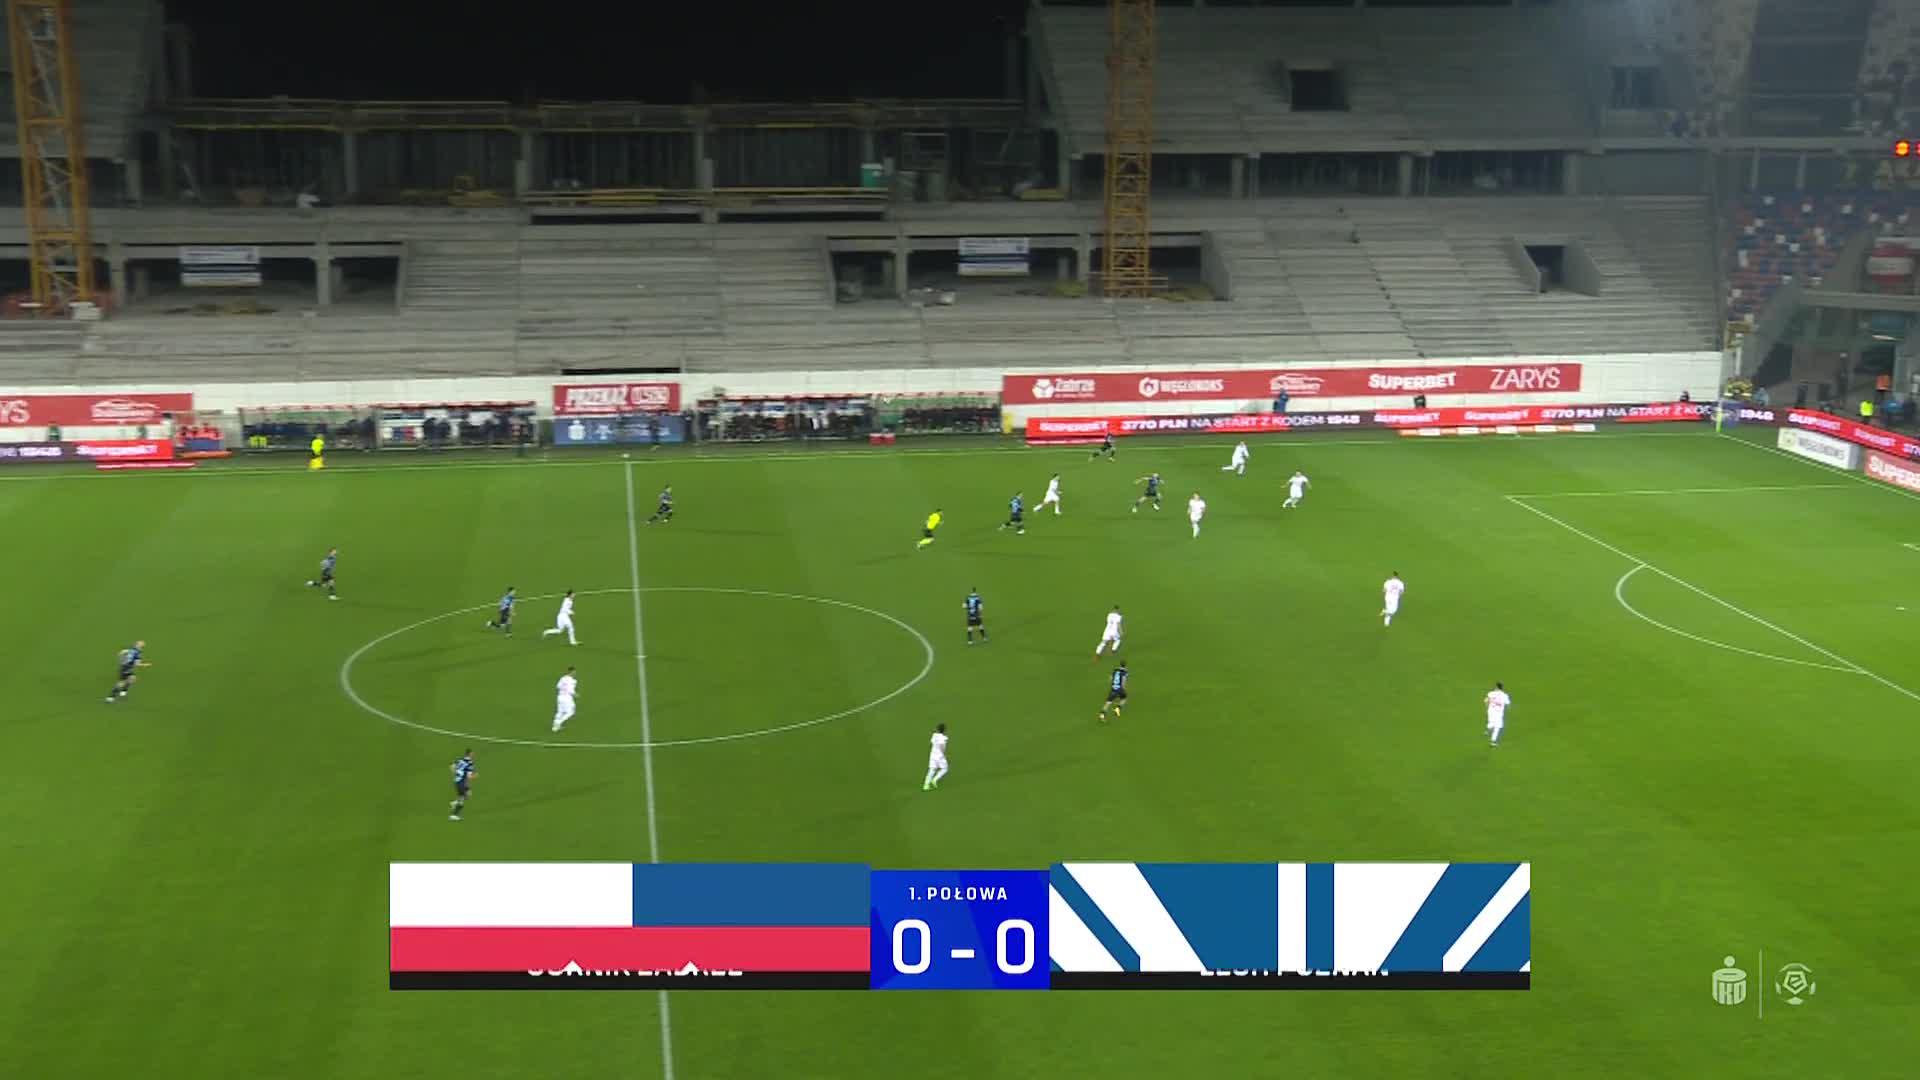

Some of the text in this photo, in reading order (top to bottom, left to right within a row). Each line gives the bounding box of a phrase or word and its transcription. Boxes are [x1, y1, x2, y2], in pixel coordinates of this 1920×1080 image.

[1368, 372, 1456, 390] SUPERBET
[1490, 367, 1560, 390] ZARYS
[1606, 407, 1627, 417] NA
[1628, 405, 1670, 417] START
[1121, 419, 1157, 430] 3770
[1159, 418, 1187, 429] PLN
[1190, 418, 1212, 428] NA
[1214, 416, 1257, 429] START
[1272, 415, 1325, 427] KODEM
